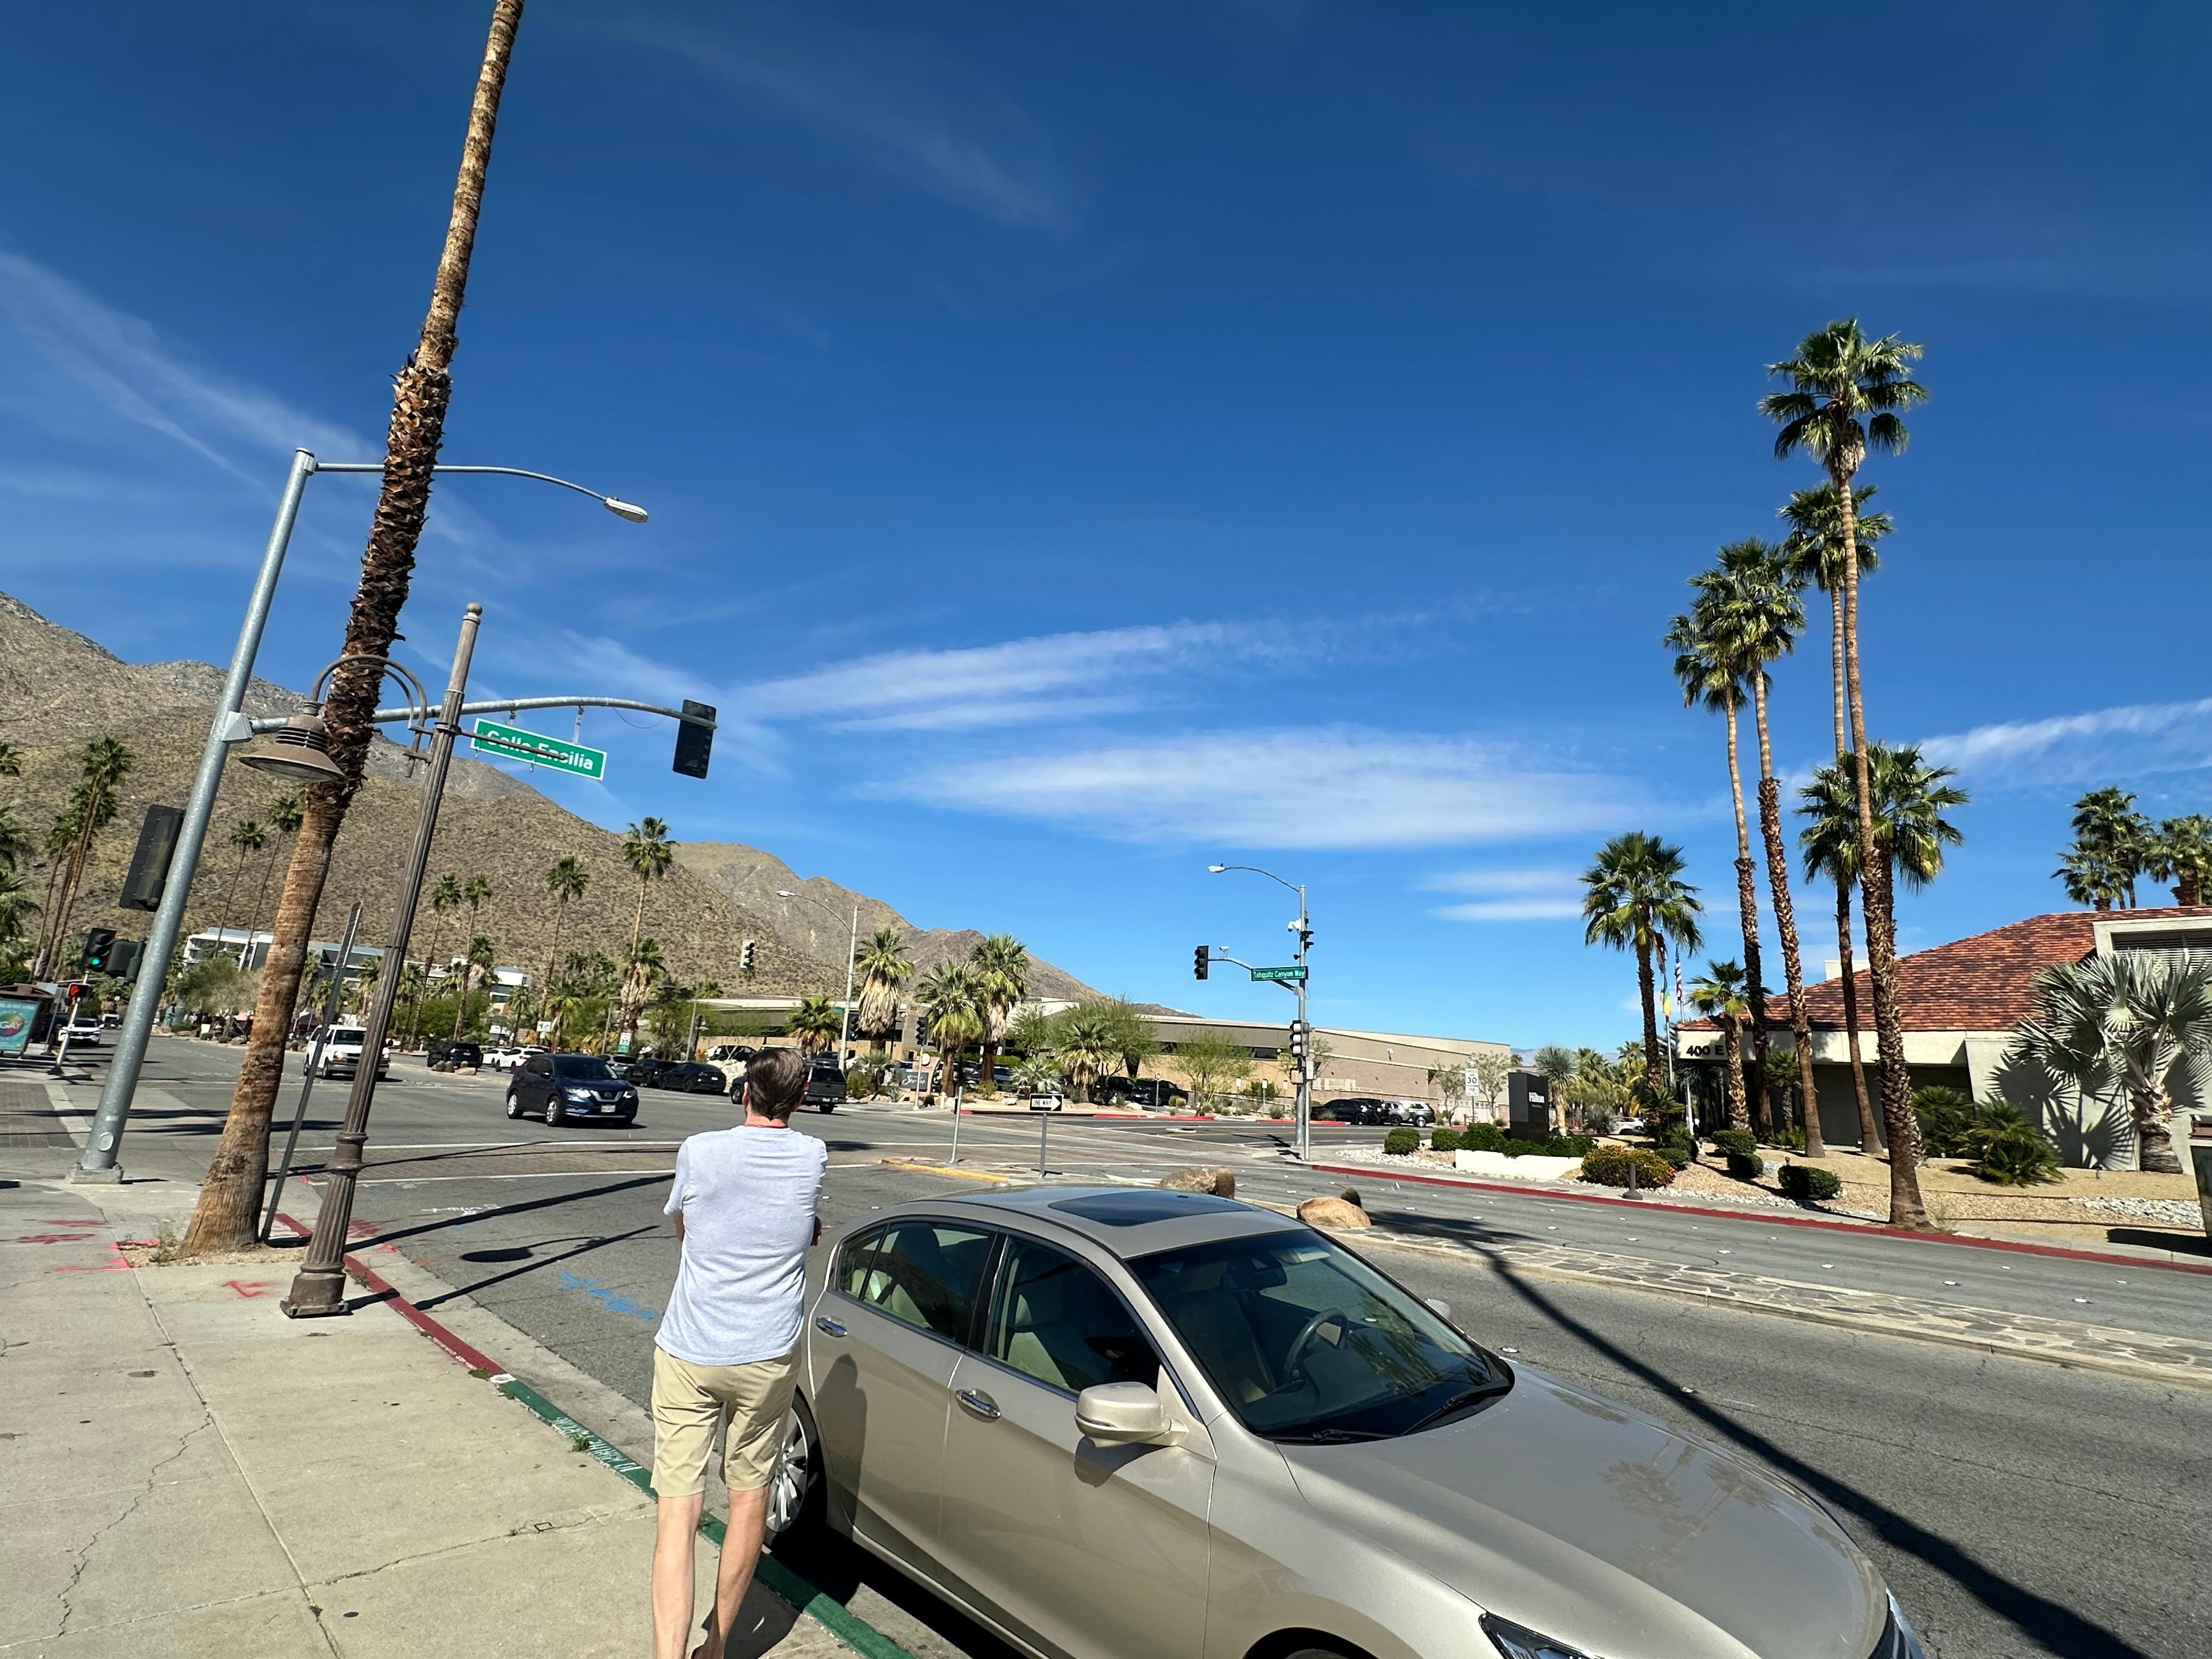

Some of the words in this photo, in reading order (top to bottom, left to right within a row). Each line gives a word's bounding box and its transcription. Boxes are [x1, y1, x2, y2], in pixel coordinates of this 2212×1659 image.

[1295, 969, 1305, 978] Way
[0, 1022, 22, 1030] GAY
[1686, 1045, 1711, 1056] 400
[1714, 1045, 1724, 1056] E
